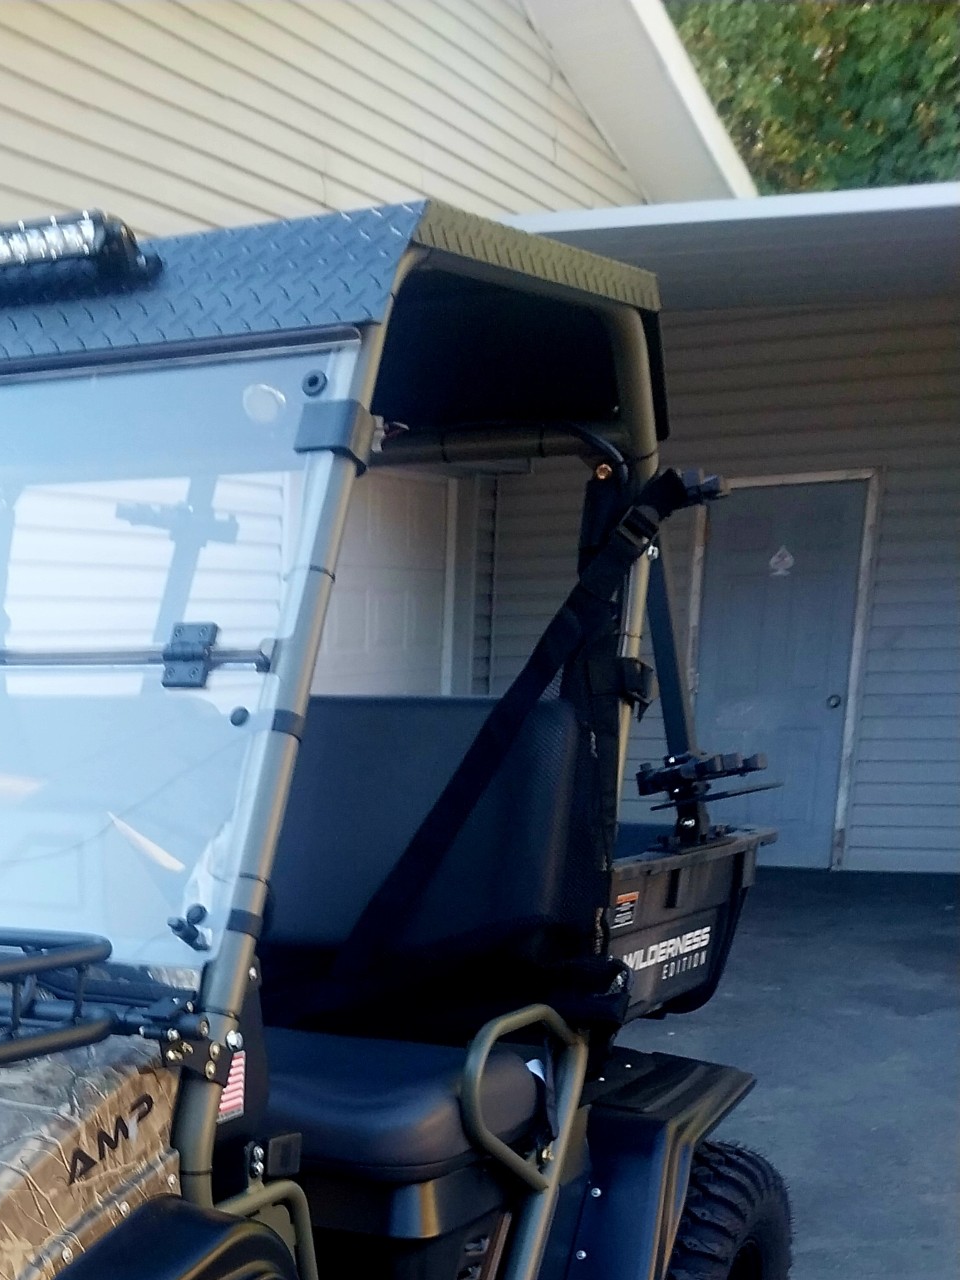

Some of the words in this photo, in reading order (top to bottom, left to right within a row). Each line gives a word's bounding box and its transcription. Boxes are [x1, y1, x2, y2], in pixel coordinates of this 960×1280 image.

[623, 926, 711, 971] WILDERNESS
[662, 950, 707, 980] EDITION
[67, 1093, 154, 1186] AMP
